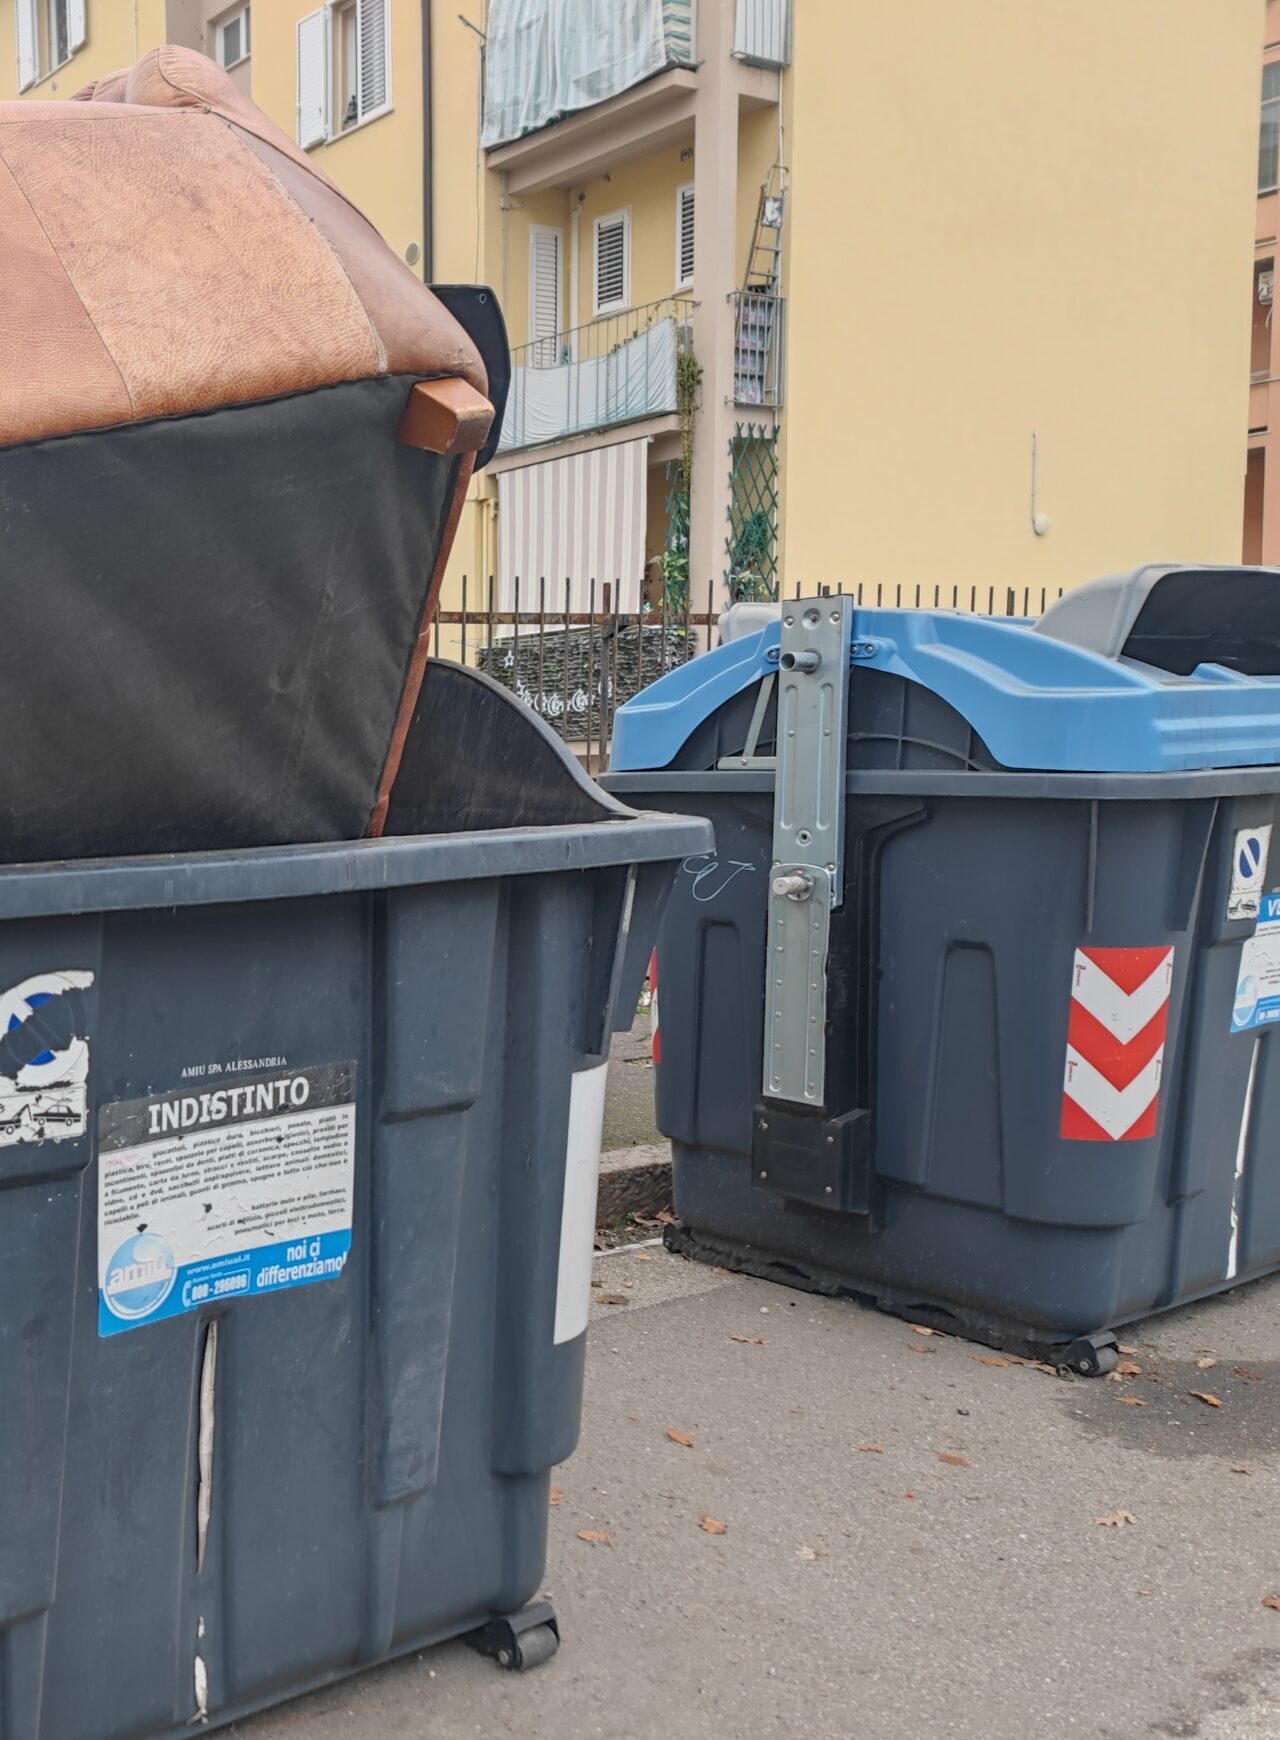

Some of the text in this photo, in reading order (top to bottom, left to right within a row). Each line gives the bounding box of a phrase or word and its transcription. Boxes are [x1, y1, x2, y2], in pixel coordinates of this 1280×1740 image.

[181, 1056, 287, 1078] AMIU SPA ALESSANDRIA
[148, 1077, 310, 1134] INDISTINTO
[287, 1237, 320, 1262] noi ci
